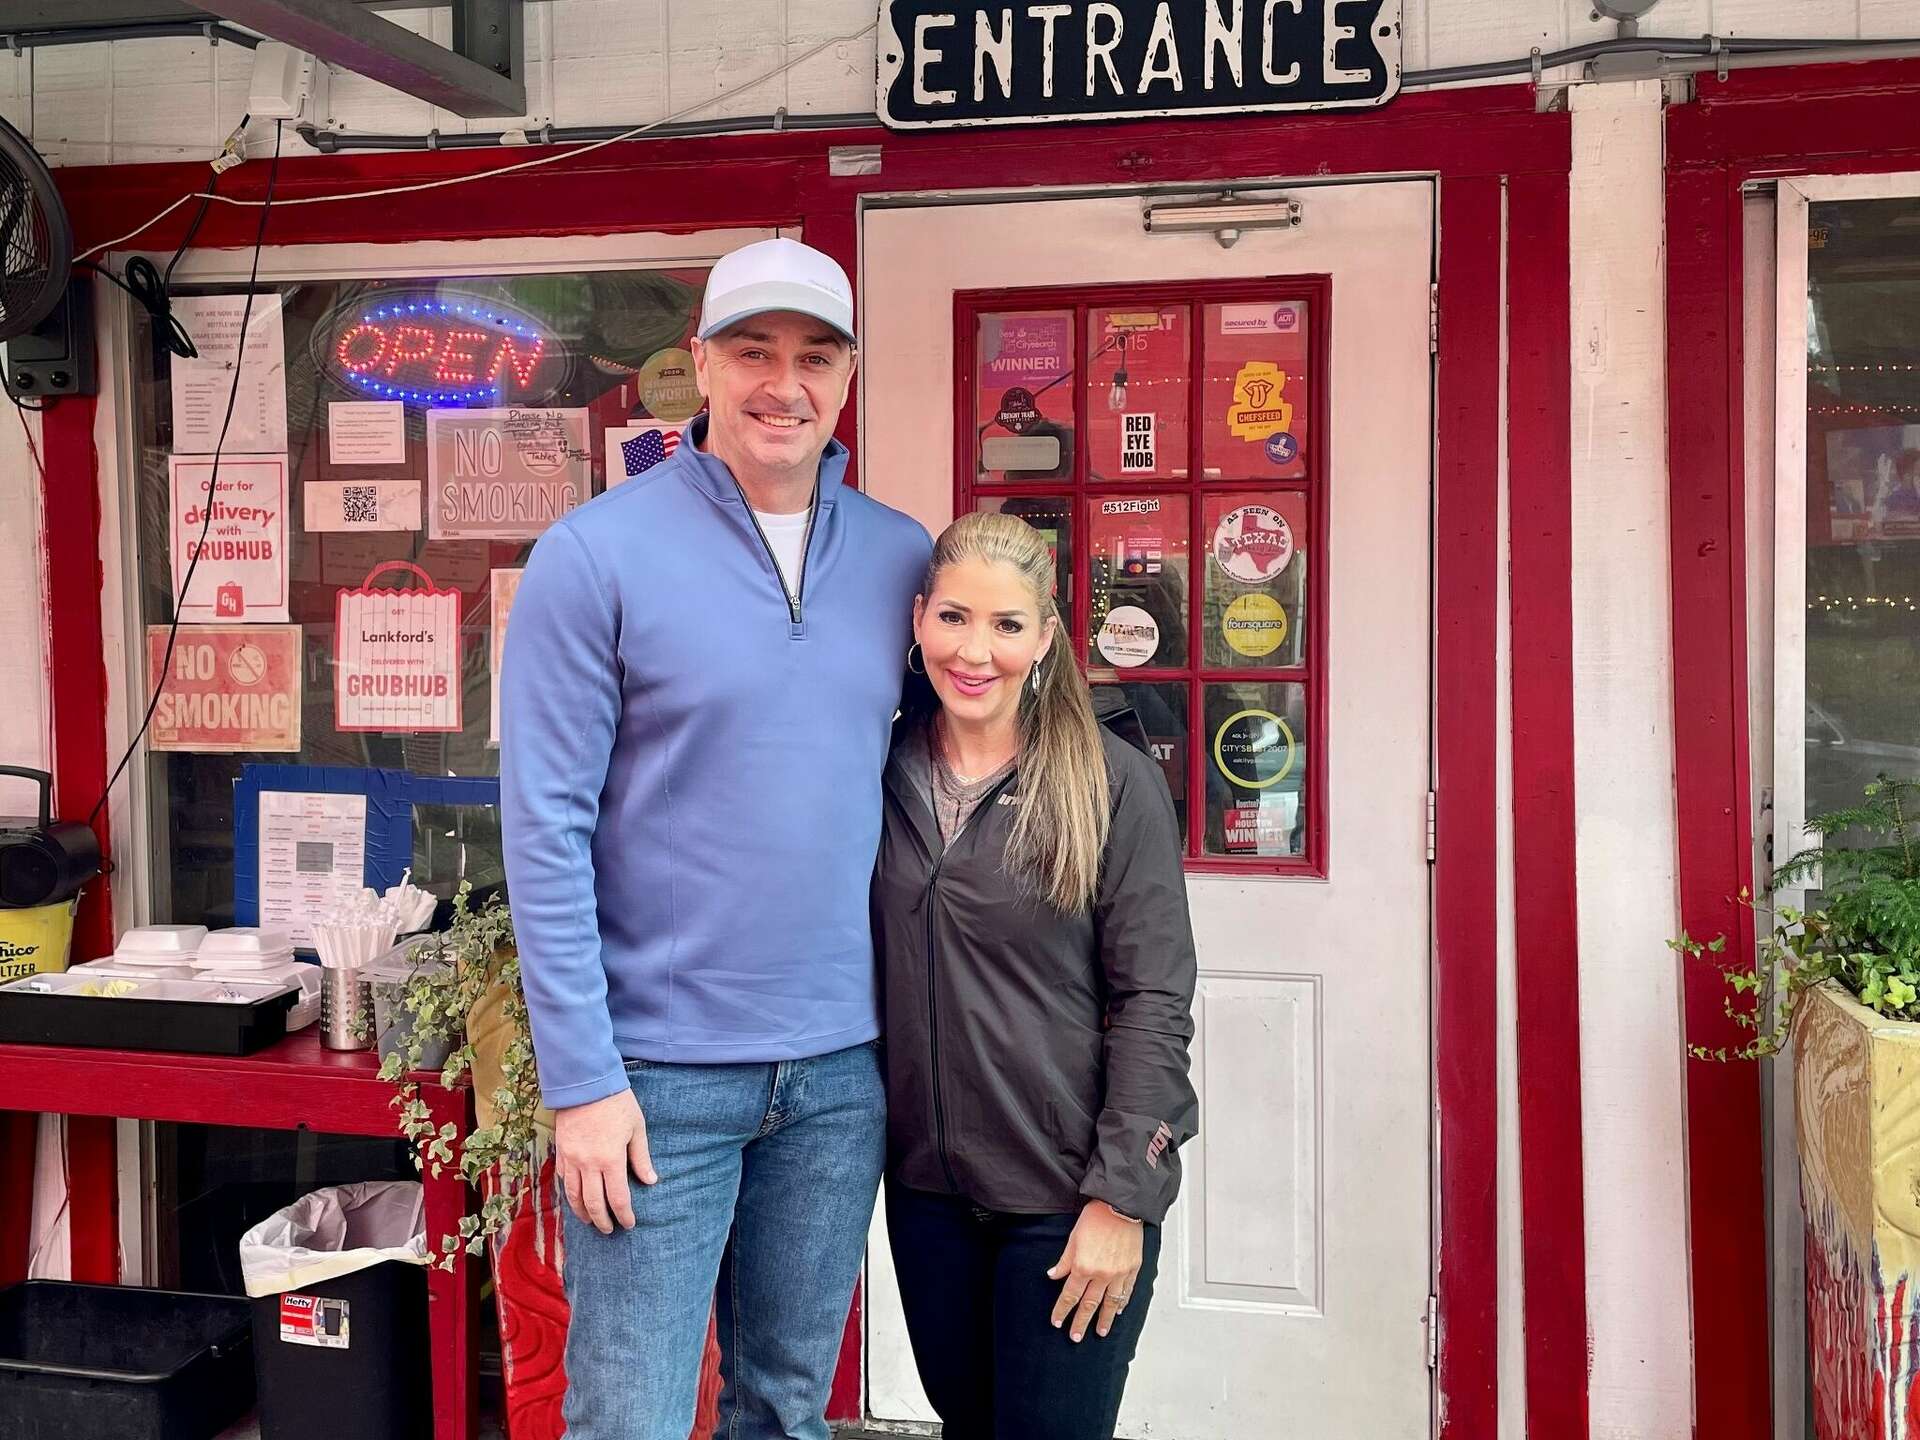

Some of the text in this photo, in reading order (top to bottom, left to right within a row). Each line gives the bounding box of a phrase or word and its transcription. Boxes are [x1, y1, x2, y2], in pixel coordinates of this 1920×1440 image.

[913, 0, 1372, 105] ENTRANCE
[1224, 318, 1268, 328] secured by
[1104, 334, 1148, 352] 2015
[336, 324, 544, 388] OPEN
[990, 356, 1060, 372] WINNER!
[509, 409, 542, 420] Please
[1238, 410, 1281, 423] CHEFSFEED
[1125, 416, 1152, 432] RED
[1126, 434, 1151, 450] EYE
[454, 428, 502, 477] NO
[1123, 452, 1154, 468] MOB
[200, 480, 254, 492] Oder for
[442, 481, 577, 523] SMOKING
[1103, 501, 1159, 513] #512Fight
[184, 501, 275, 528] delivery
[1227, 507, 1286, 528] AS SEEN ON
[216, 525, 242, 536] with
[1233, 531, 1287, 549] TEXAS
[186, 540, 273, 561] GRUBHUB
[1227, 617, 1282, 632] foursquare
[361, 630, 435, 643] Lankford's
[175, 644, 216, 681] NO
[346, 674, 448, 697] GRUBHUB
[156, 692, 290, 730] SMOKING
[0, 963, 36, 977] LTZER
[285, 1297, 311, 1308] Hefty
